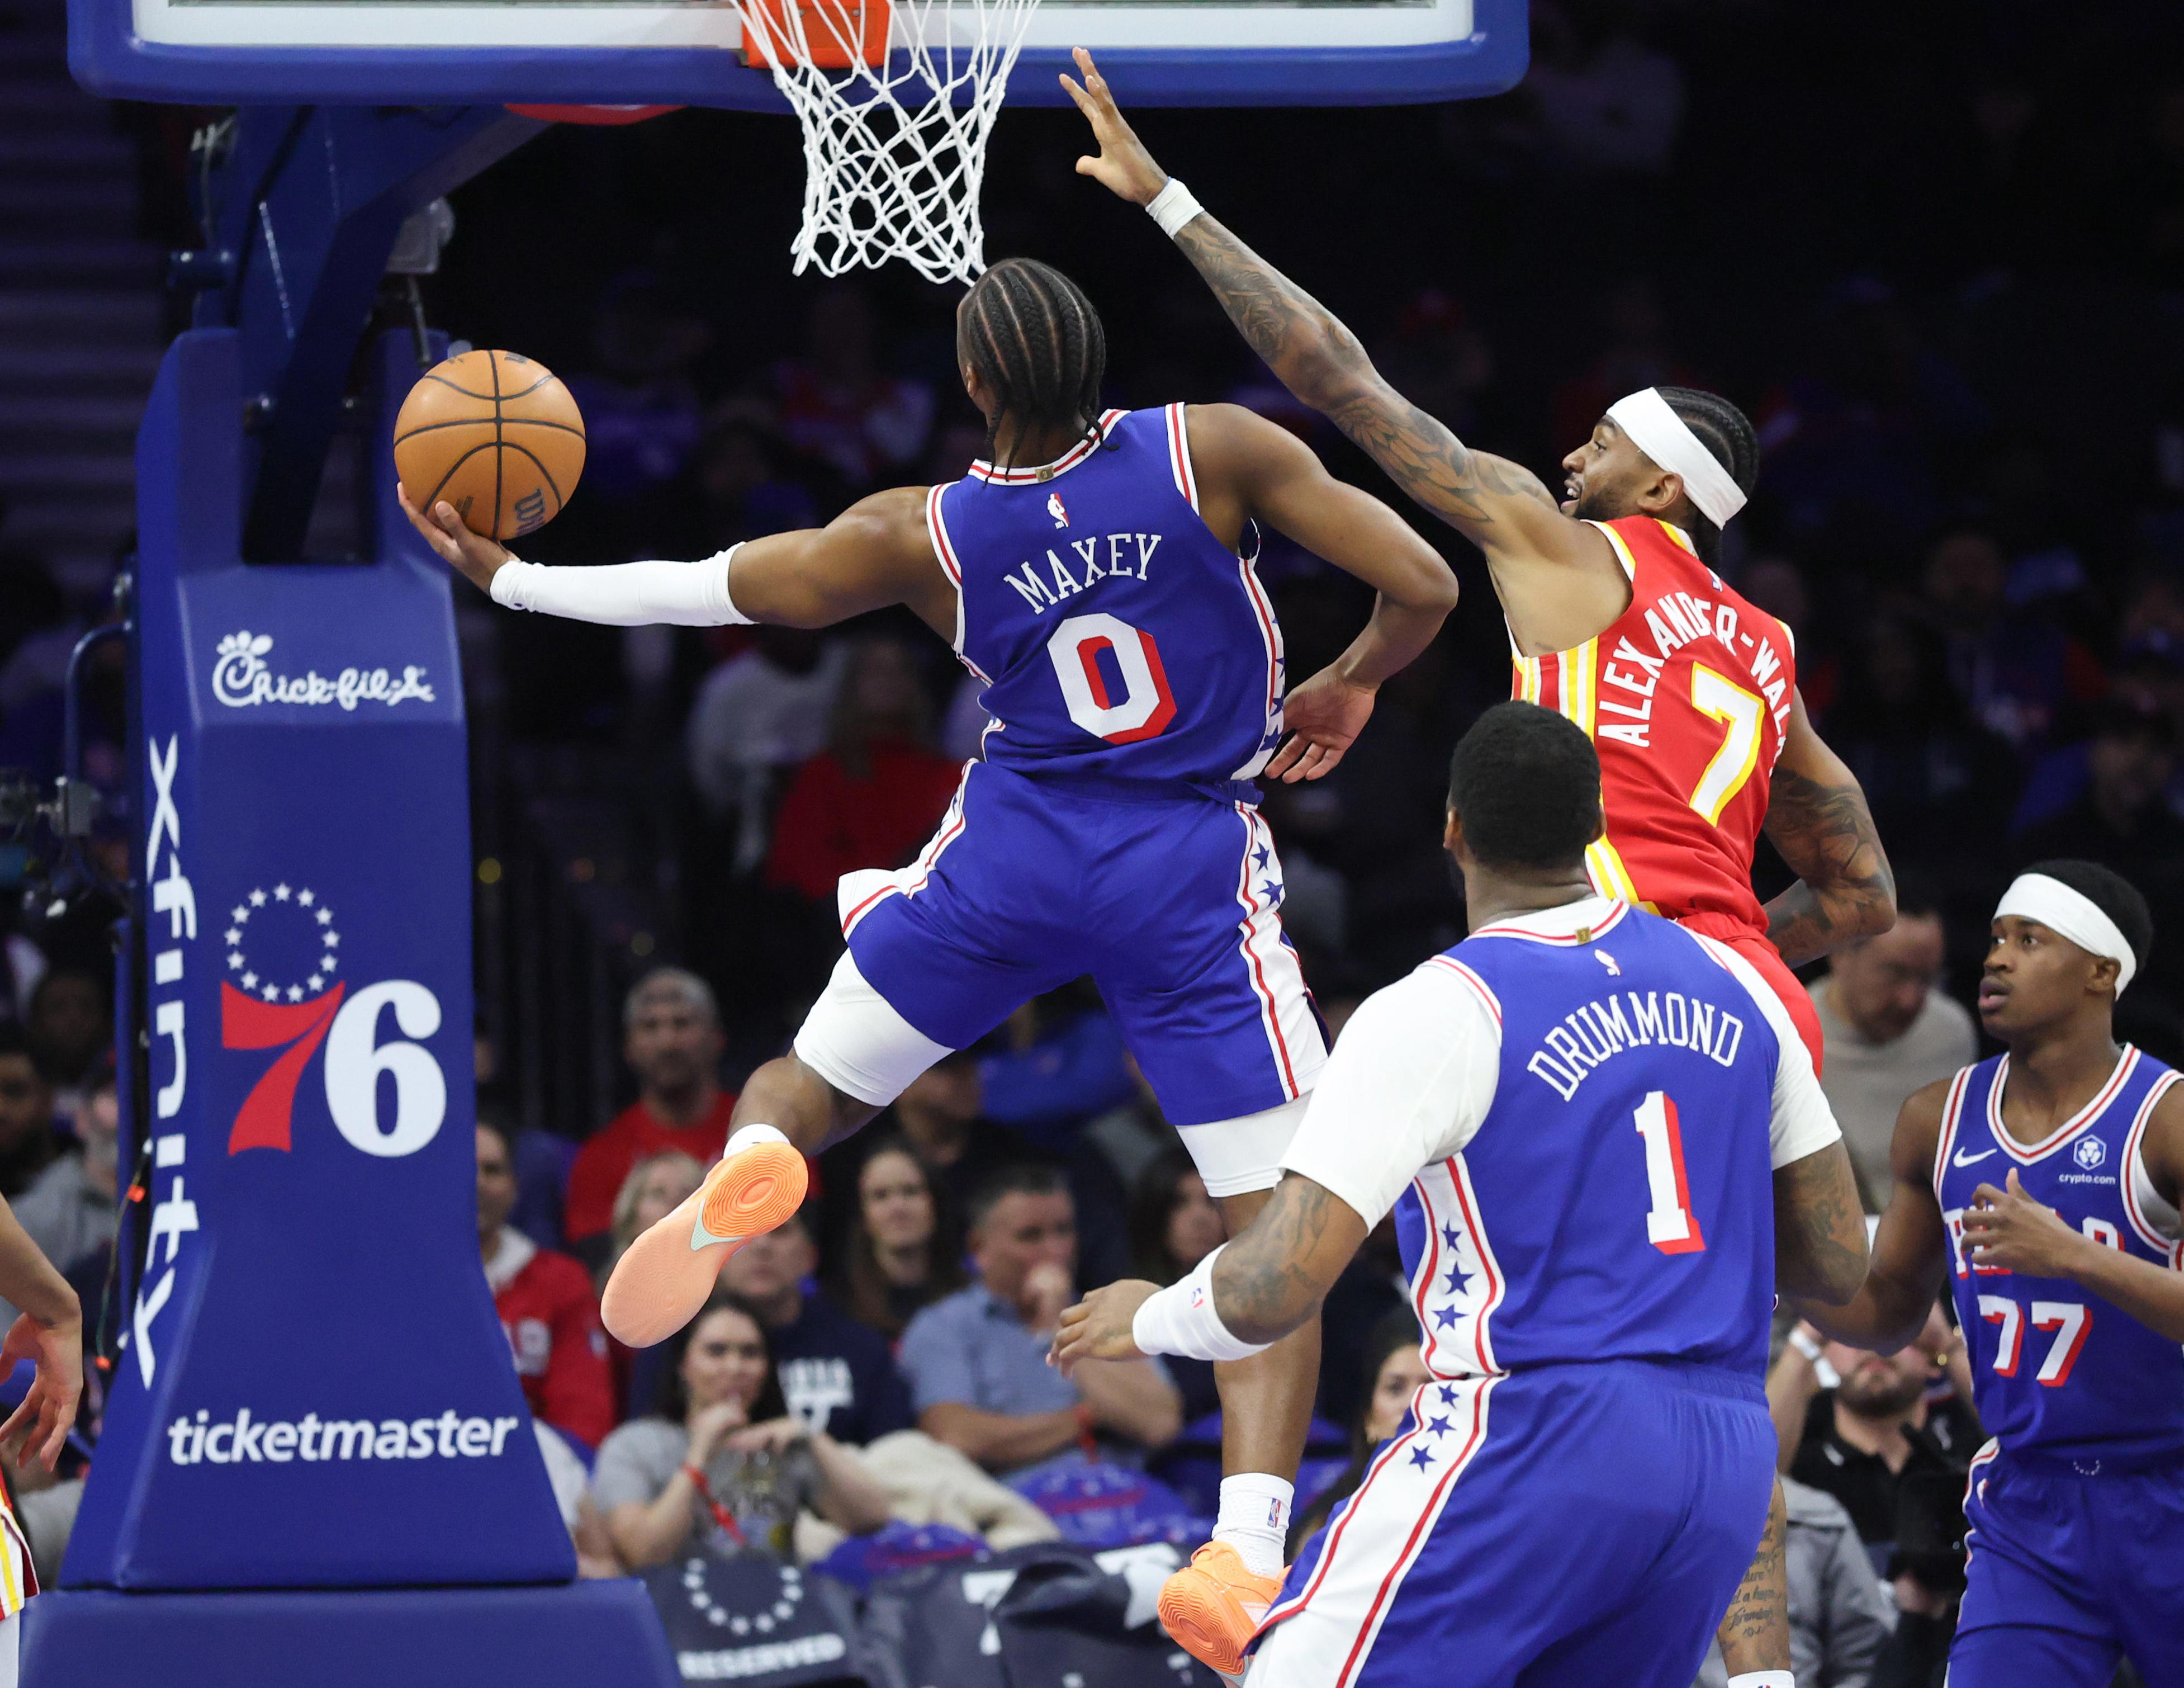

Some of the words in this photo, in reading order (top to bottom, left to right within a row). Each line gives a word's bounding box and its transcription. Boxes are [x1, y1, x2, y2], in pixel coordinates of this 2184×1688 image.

[1003, 533, 1162, 615] MAXEY
[212, 630, 436, 711] Chick-fil-A
[1046, 612, 1177, 745] 0
[1598, 592, 1790, 777] ALEXANDER-WAL
[1689, 661, 1765, 827] 7
[133, 732, 199, 1391] xfinity
[221, 978, 447, 1157] 76
[1527, 991, 1744, 1102] DRUMMOND
[1633, 1090, 1707, 1256] 1
[2058, 1174, 2116, 1186] crypto.com
[1977, 1294, 2093, 1388] 77
[167, 1407, 519, 1465] ticketmaster
